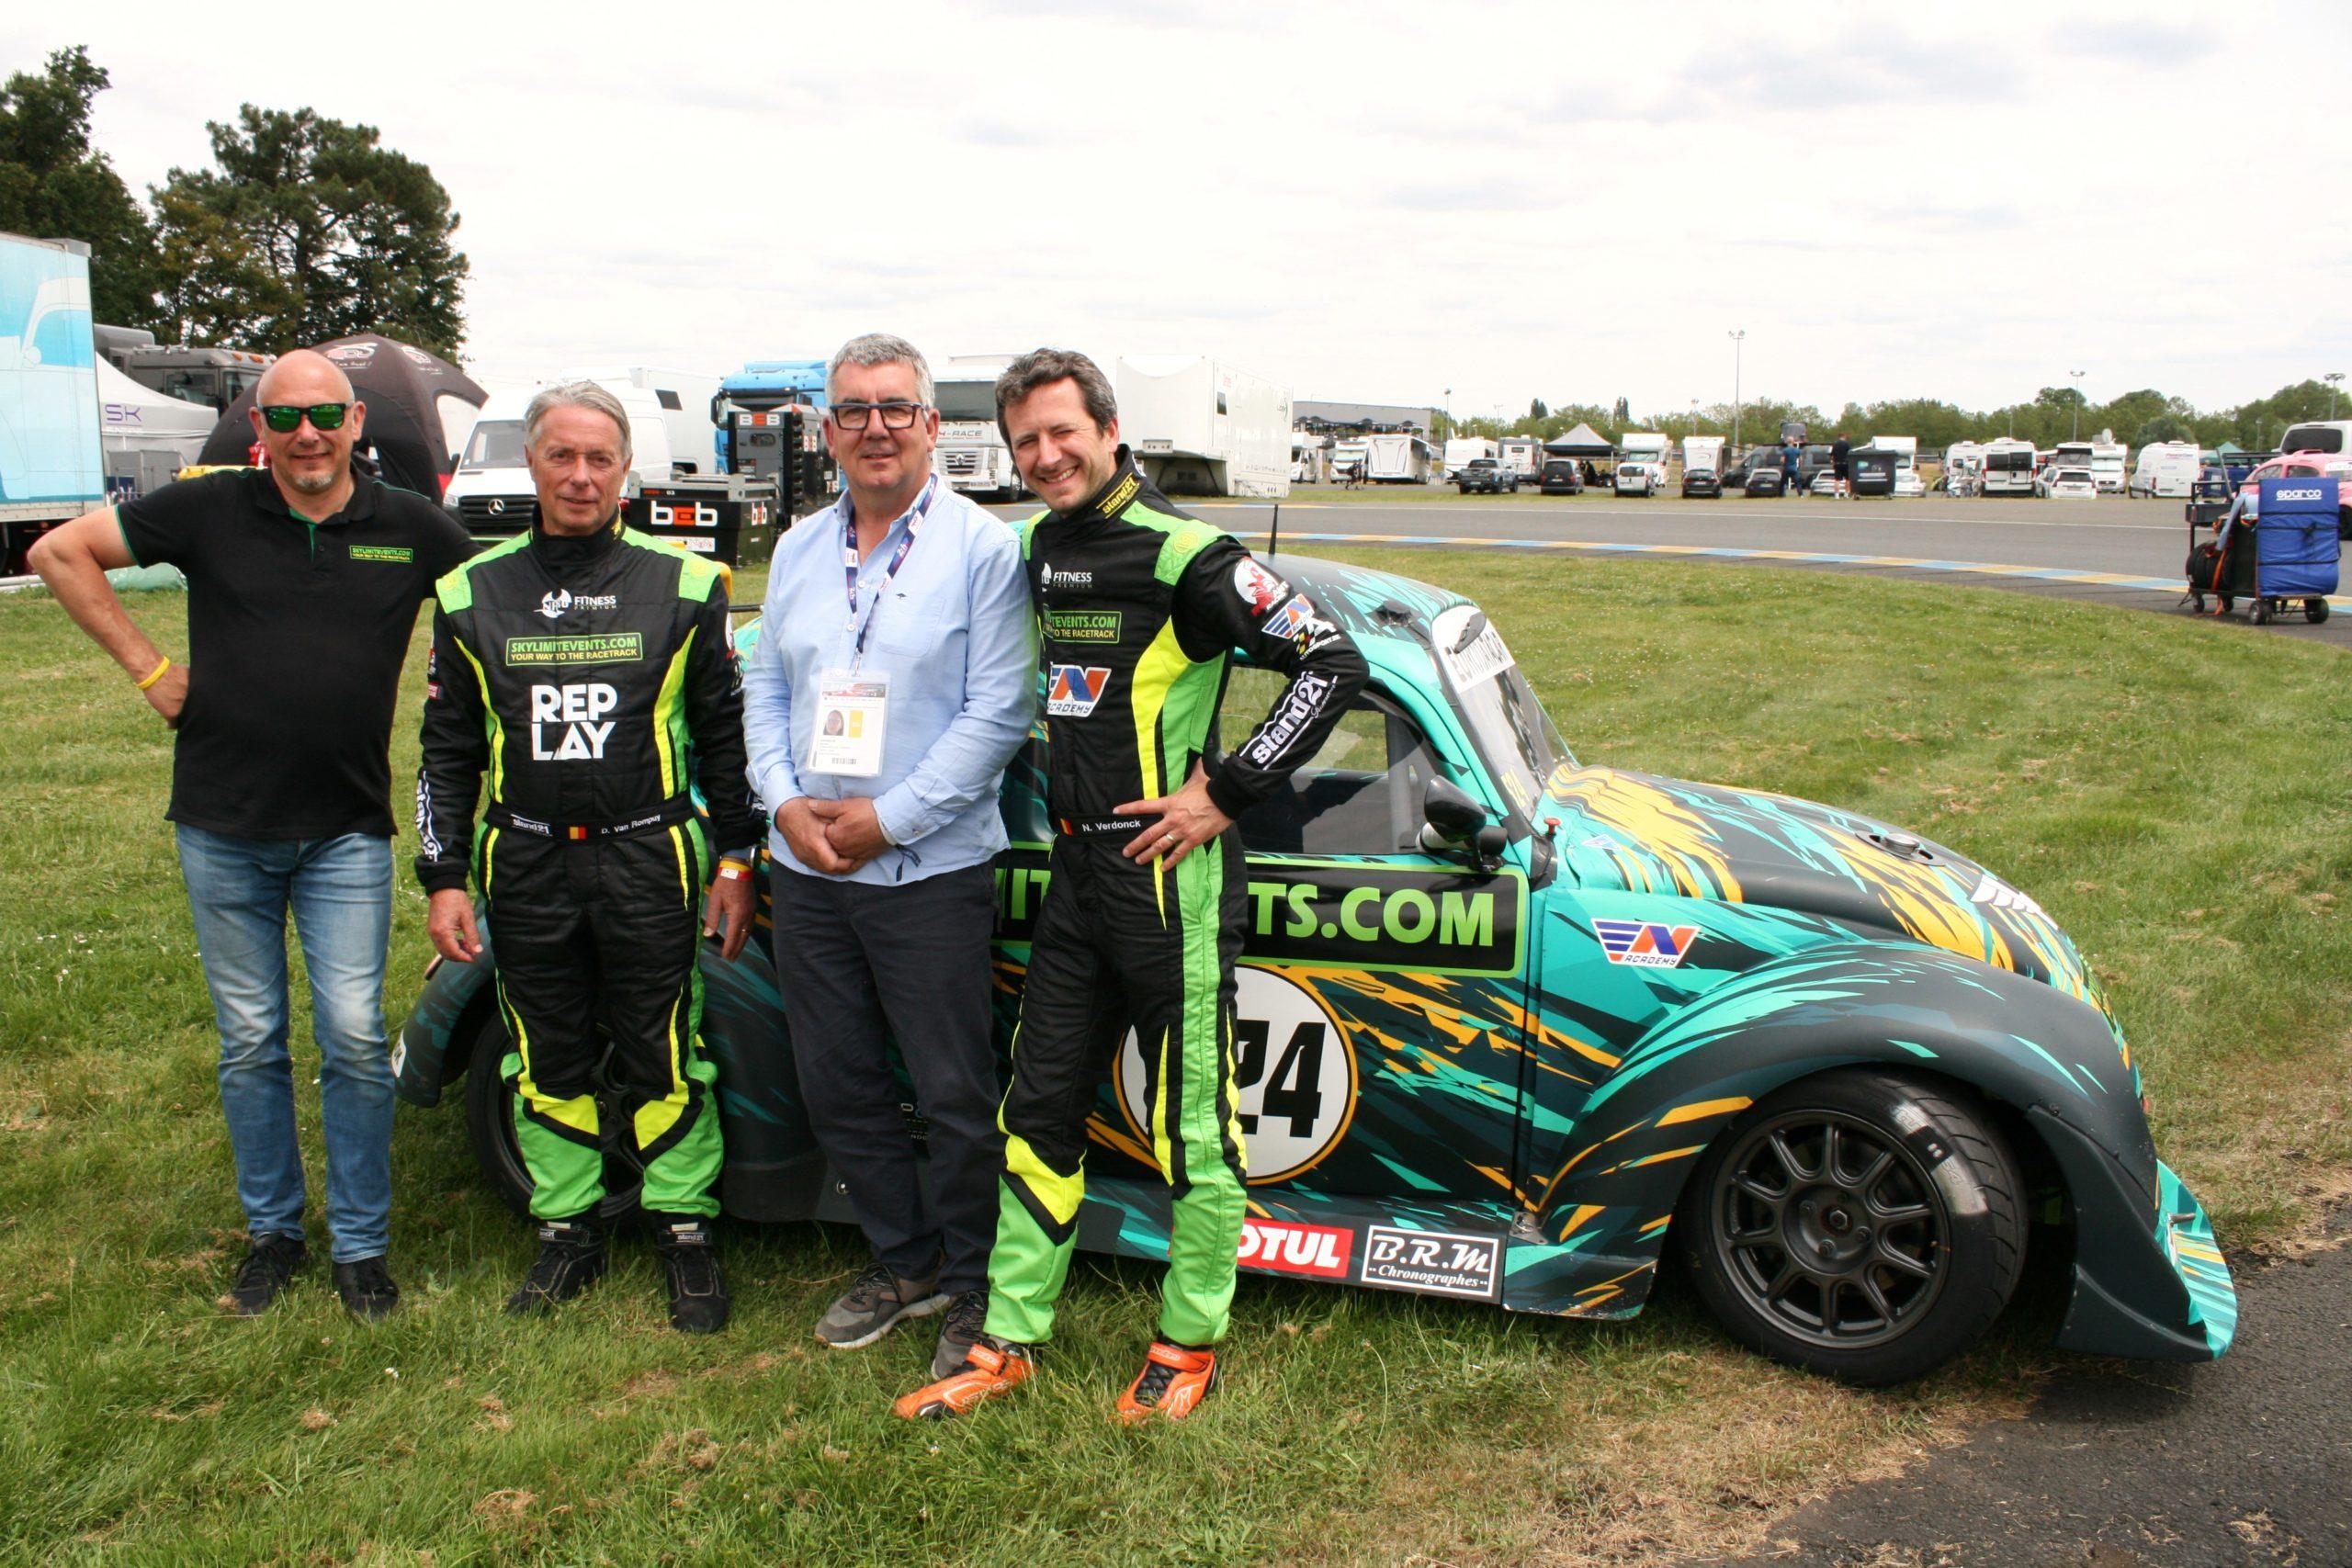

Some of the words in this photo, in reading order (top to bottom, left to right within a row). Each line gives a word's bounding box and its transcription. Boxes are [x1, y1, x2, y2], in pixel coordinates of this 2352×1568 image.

[739, 412, 780, 426] BEB
[2276, 489, 2323, 500] sparco
[1053, 571, 1092, 582] FITNESS
[574, 595, 617, 606] FITNESS
[1049, 615, 1116, 628] TEVENTS.COM
[1072, 629, 1114, 638] RACETRACK
[511, 637, 638, 653] SKYLIMITEVENTS.COM
[511, 652, 535, 661] YOUR
[536, 651, 554, 660] WAY
[556, 651, 567, 660] TO
[569, 650, 584, 660] THE
[586, 648, 638, 660] RACETRACK
[531, 683, 617, 722] REP
[1251, 674, 1329, 765] stand21
[531, 721, 616, 761] LAY
[614, 823, 629, 833] Van
[631, 814, 662, 829] Rompuy
[1081, 823, 1093, 832] N.
[1095, 818, 1142, 831] Verdonck
[1624, 953, 1678, 965] ACADEMY
[1237, 1019, 1326, 1138] 24
[1236, 1224, 1340, 1269] OTUL
[1378, 1263, 1479, 1288] Chronographes
